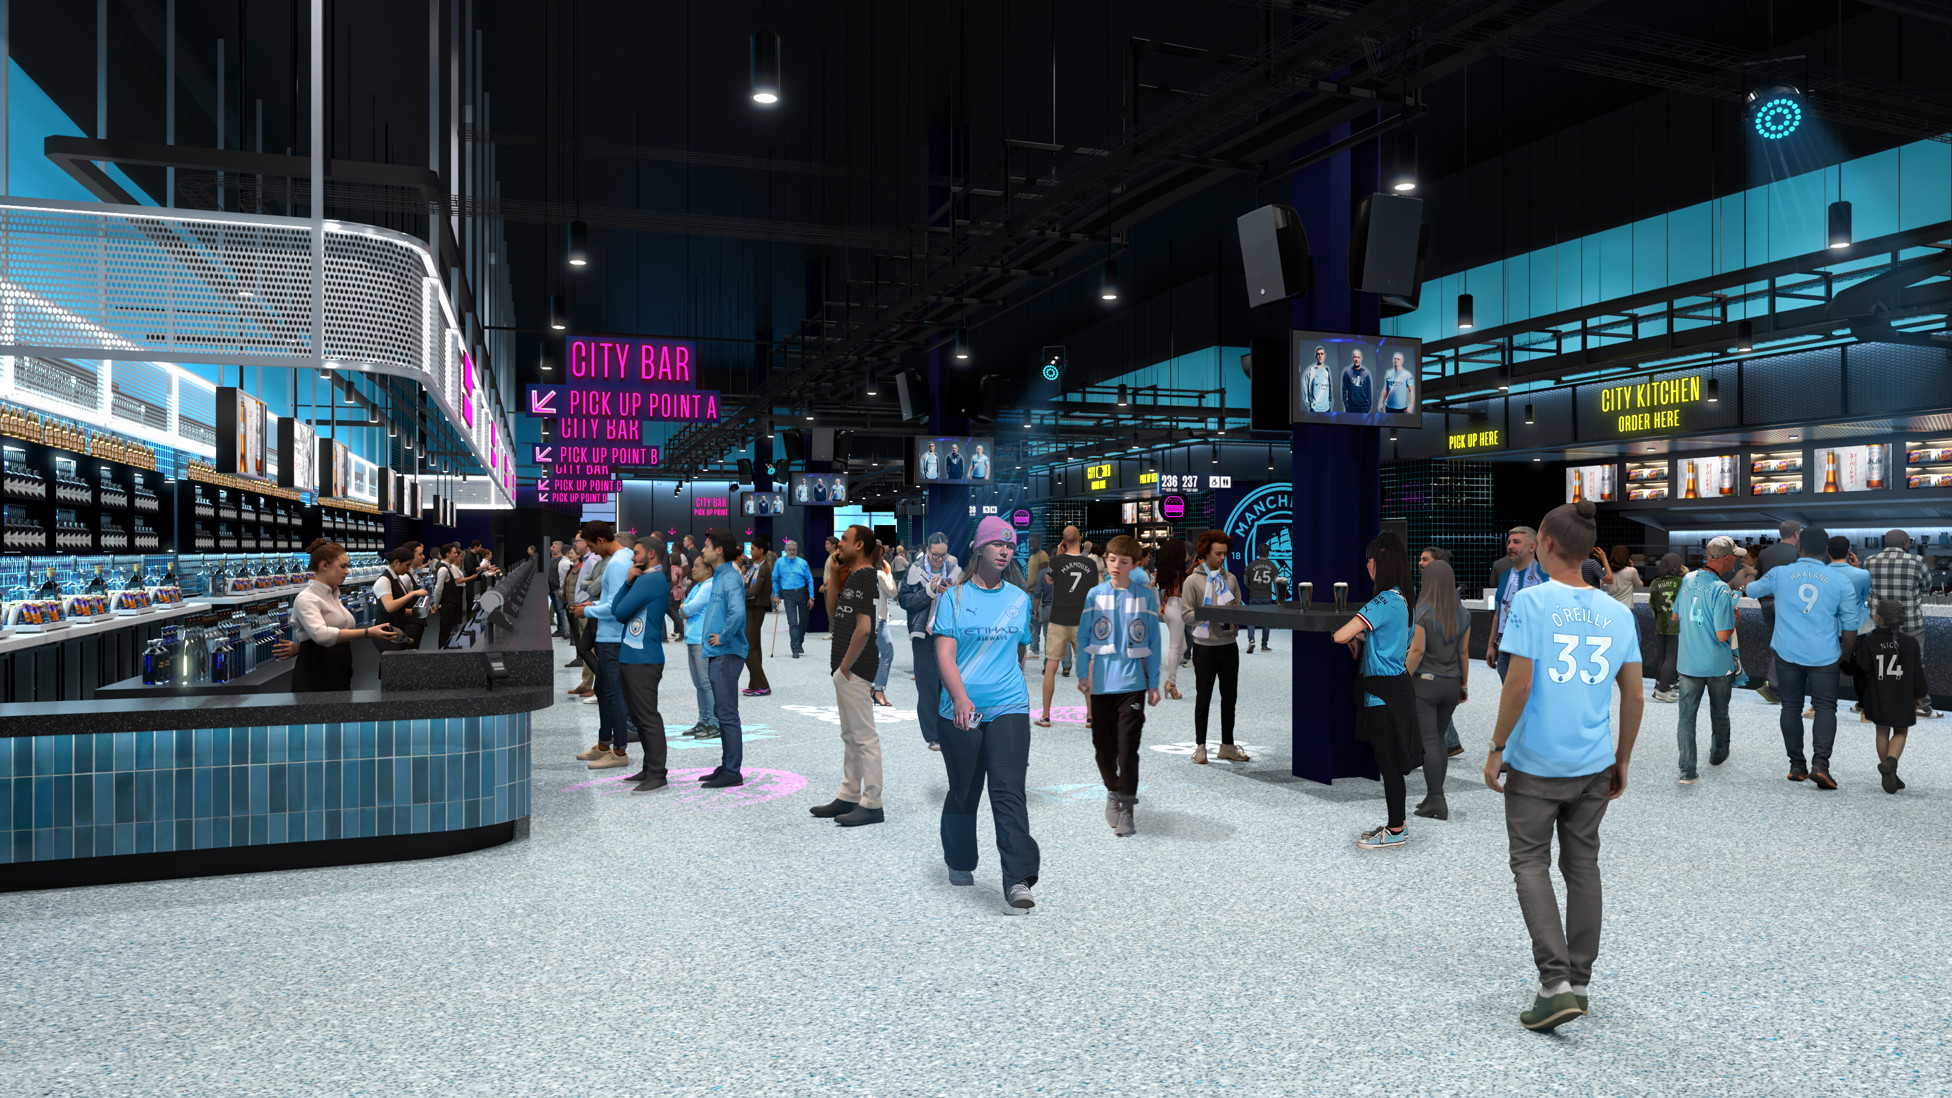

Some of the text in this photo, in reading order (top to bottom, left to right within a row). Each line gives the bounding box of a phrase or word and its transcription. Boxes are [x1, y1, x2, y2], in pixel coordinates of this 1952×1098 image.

[573, 342, 688, 380] CITY BAR
[571, 391, 716, 418] PICK UP POINT A
[1602, 376, 1699, 412] CITY KITCHEN
[562, 418, 638, 439] CITY BAR
[1619, 410, 1679, 432] ORDER HERE
[1449, 431, 1498, 449] PICK UP HERE
[561, 447, 657, 464] PICK UP POINT B
[554, 479, 622, 492] PICK UP POINT C
[1161, 475, 1178, 487] 236
[1182, 475, 1198, 487] 237
[552, 493, 569, 503] PICK
[569, 493, 579, 503] UP
[581, 493, 601, 503] POINT
[696, 497, 727, 508] CITY BAR
[1235, 494, 1293, 538] MANCH
[1231, 552, 1241, 560] 18
[1061, 562, 1091, 574] MARMOUSH
[1253, 570, 1272, 584] 45
[1789, 570, 1830, 585] HAALAND
[1069, 572, 1082, 593] 7
[1662, 591, 1674, 612] 3
[1798, 583, 1819, 615] 9
[1551, 604, 1612, 630] O'REILLY
[1690, 597, 1704, 627] 4
[964, 626, 1019, 636] ETIHAD
[1548, 633, 1613, 686] 33
[1876, 654, 1904, 680] 14
